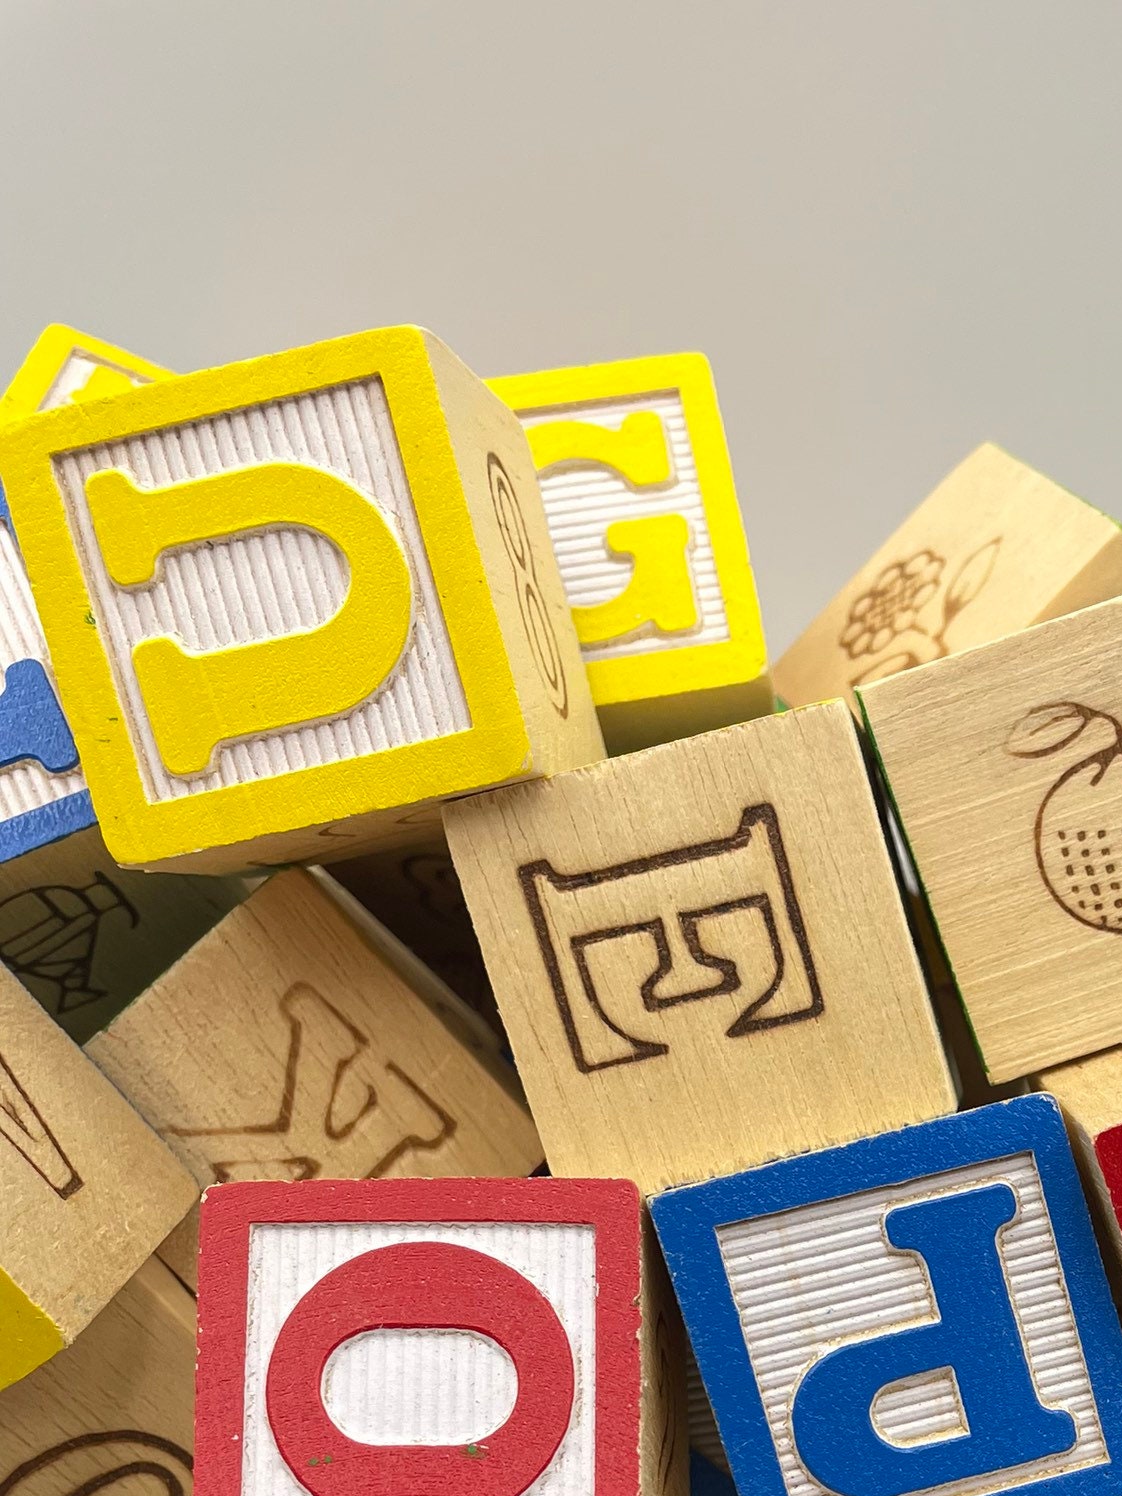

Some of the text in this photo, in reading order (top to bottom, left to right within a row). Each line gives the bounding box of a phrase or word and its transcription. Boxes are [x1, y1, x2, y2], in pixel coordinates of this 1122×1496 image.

[84, 460, 414, 778] U
[486, 451, 570, 721] 8
[522, 409, 702, 647] G
[519, 801, 826, 1075] E
